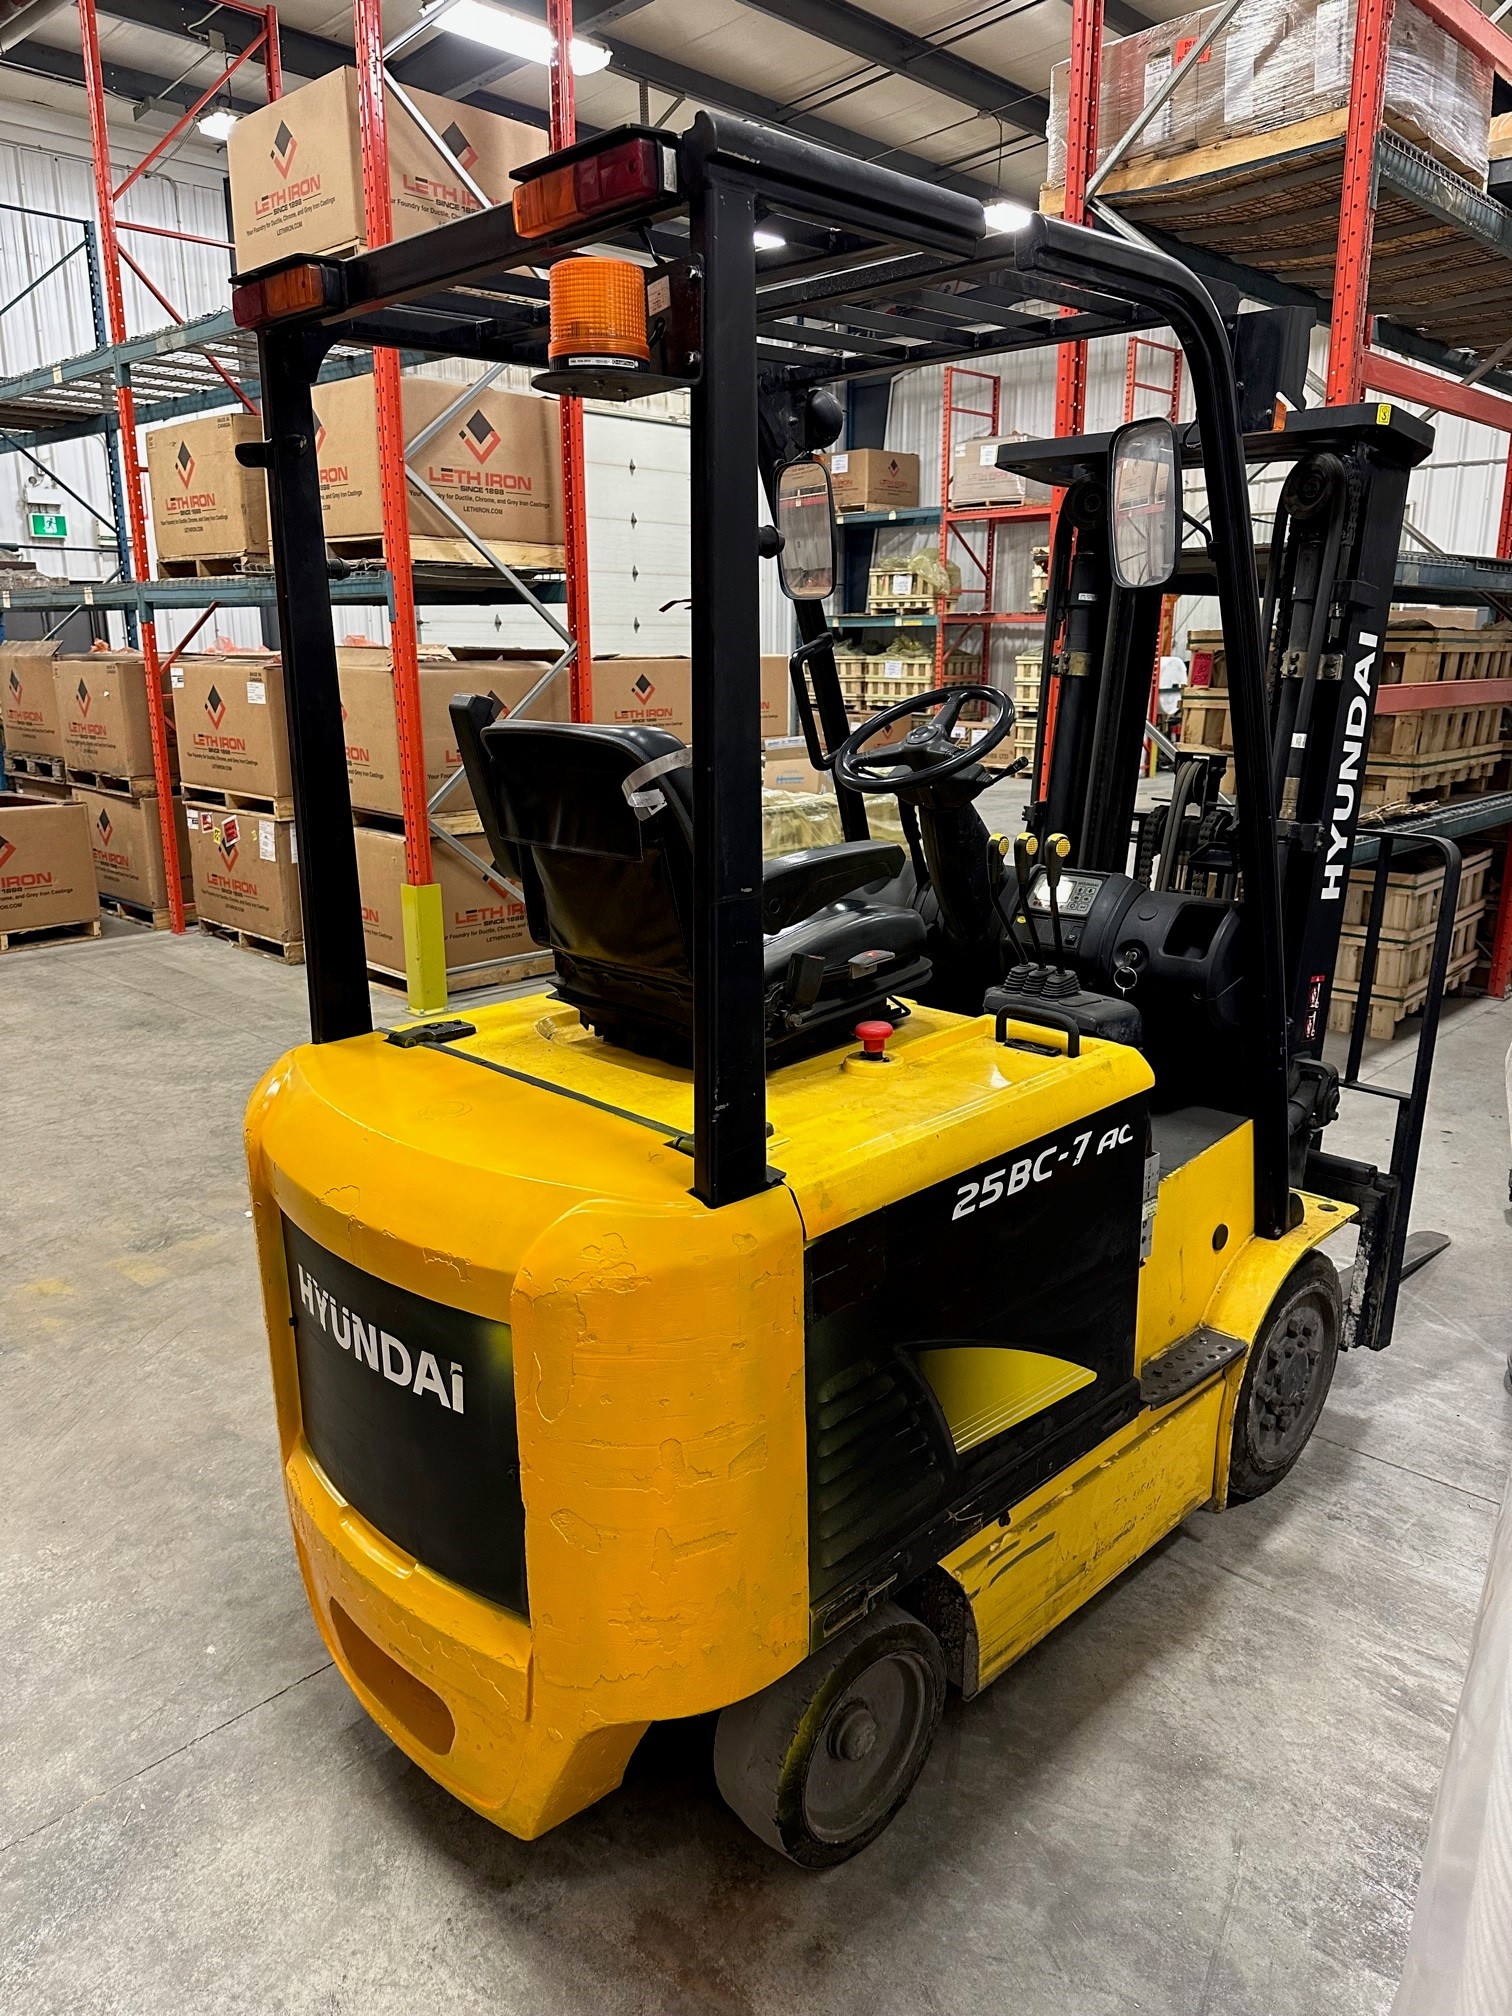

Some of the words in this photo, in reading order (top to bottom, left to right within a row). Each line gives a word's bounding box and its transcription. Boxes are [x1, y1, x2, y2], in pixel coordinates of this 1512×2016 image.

[255, 188, 286, 215] LETH
[288, 174, 320, 200] IRON
[402, 174, 458, 202] LETH
[397, 199, 420, 211] Foundry
[436, 199, 460, 211] SINCE
[428, 466, 480, 488] LETH
[485, 472, 532, 491] IRON
[460, 485, 484, 494] SINCE
[485, 487, 504, 495] 1898
[166, 496, 189, 511] LETH
[190, 493, 216, 508] IRON
[463, 506, 503, 514] LETHIRON.COM
[530, 501, 550, 509] Castings
[615, 710, 644, 719] LETH
[646, 708, 673, 717] IRON
[193, 734, 218, 747] LETH
[218, 737, 246, 750] IRON
[1320, 632, 1378, 900] HYUNDAI
[1, 872, 52, 888] IRON
[207, 872, 231, 888] LETH
[231, 879, 257, 895] IRON
[455, 906, 503, 925] LETH
[483, 918, 505, 926] SINCE
[952, 1130, 1093, 1221] 25BC-7
[1096, 1124, 1134, 1156] AC
[298, 1262, 464, 1415] HYUNDAI
